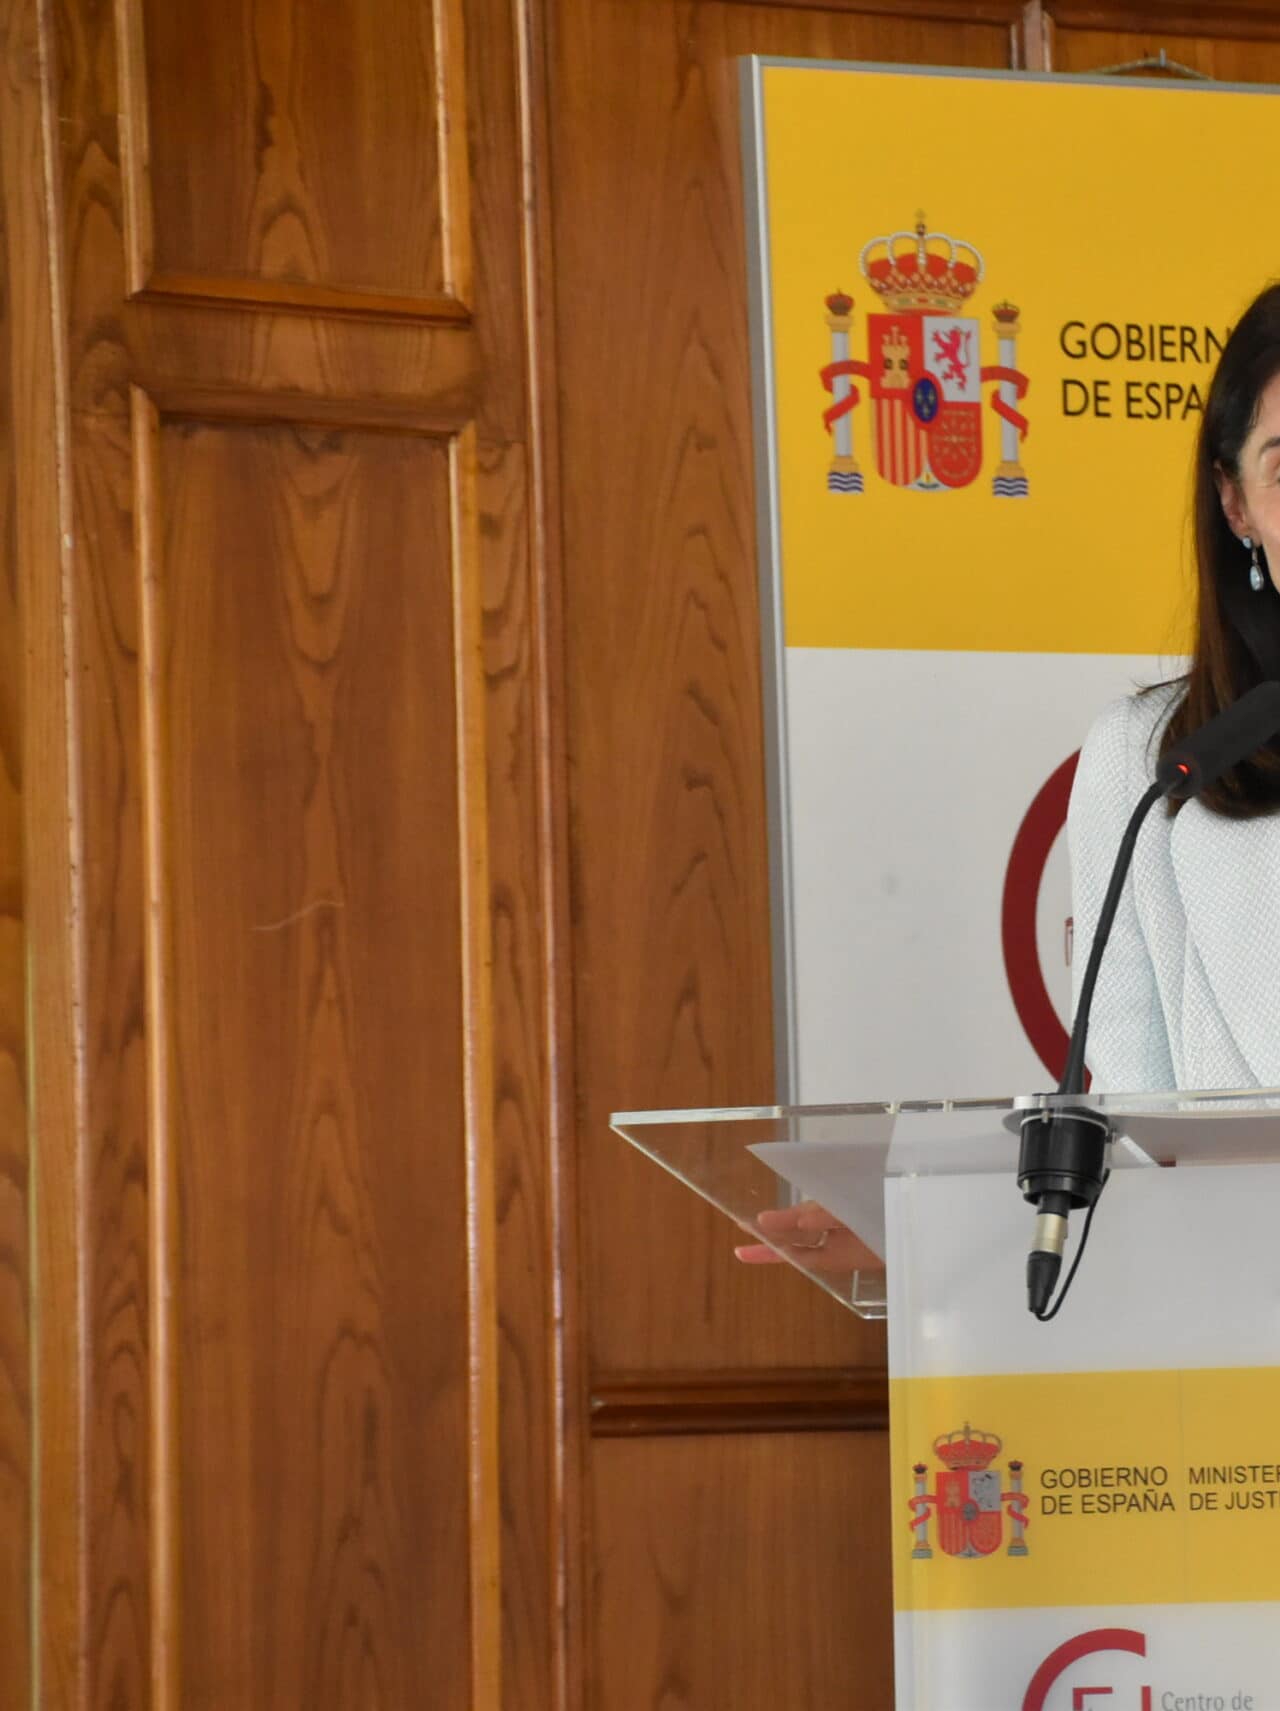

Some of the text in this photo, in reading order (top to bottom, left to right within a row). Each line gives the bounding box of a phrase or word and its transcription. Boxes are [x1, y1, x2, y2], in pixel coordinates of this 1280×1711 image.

[1059, 320, 1231, 364] GOBIERN
[1062, 378, 1206, 421] DE ESPA
[1040, 1465, 1169, 1489] GOBIERNO
[1041, 1488, 1176, 1515] DE ESPAÑA
[1189, 1492, 1218, 1511] DE
[1160, 1688, 1254, 1711] Centro de
